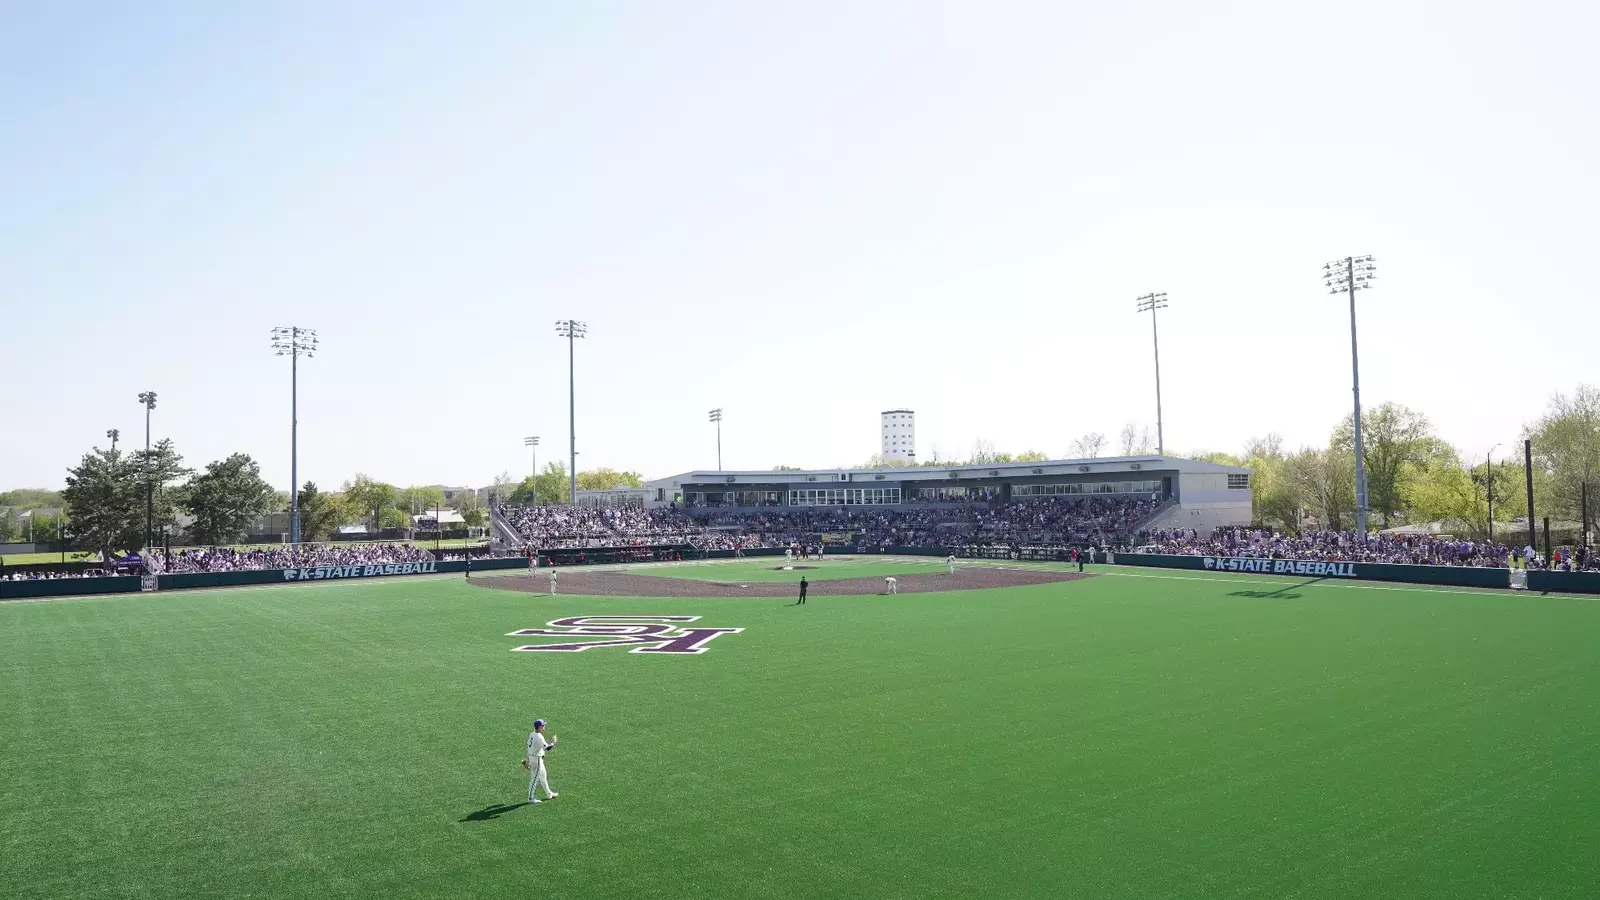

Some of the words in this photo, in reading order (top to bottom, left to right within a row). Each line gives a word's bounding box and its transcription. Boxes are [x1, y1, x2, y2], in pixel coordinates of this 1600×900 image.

[299, 566, 361, 580] K-STATE
[363, 562, 437, 577] BASEBALL
[1216, 559, 1272, 572] K-STATE
[1274, 561, 1357, 576] BASEBALL
